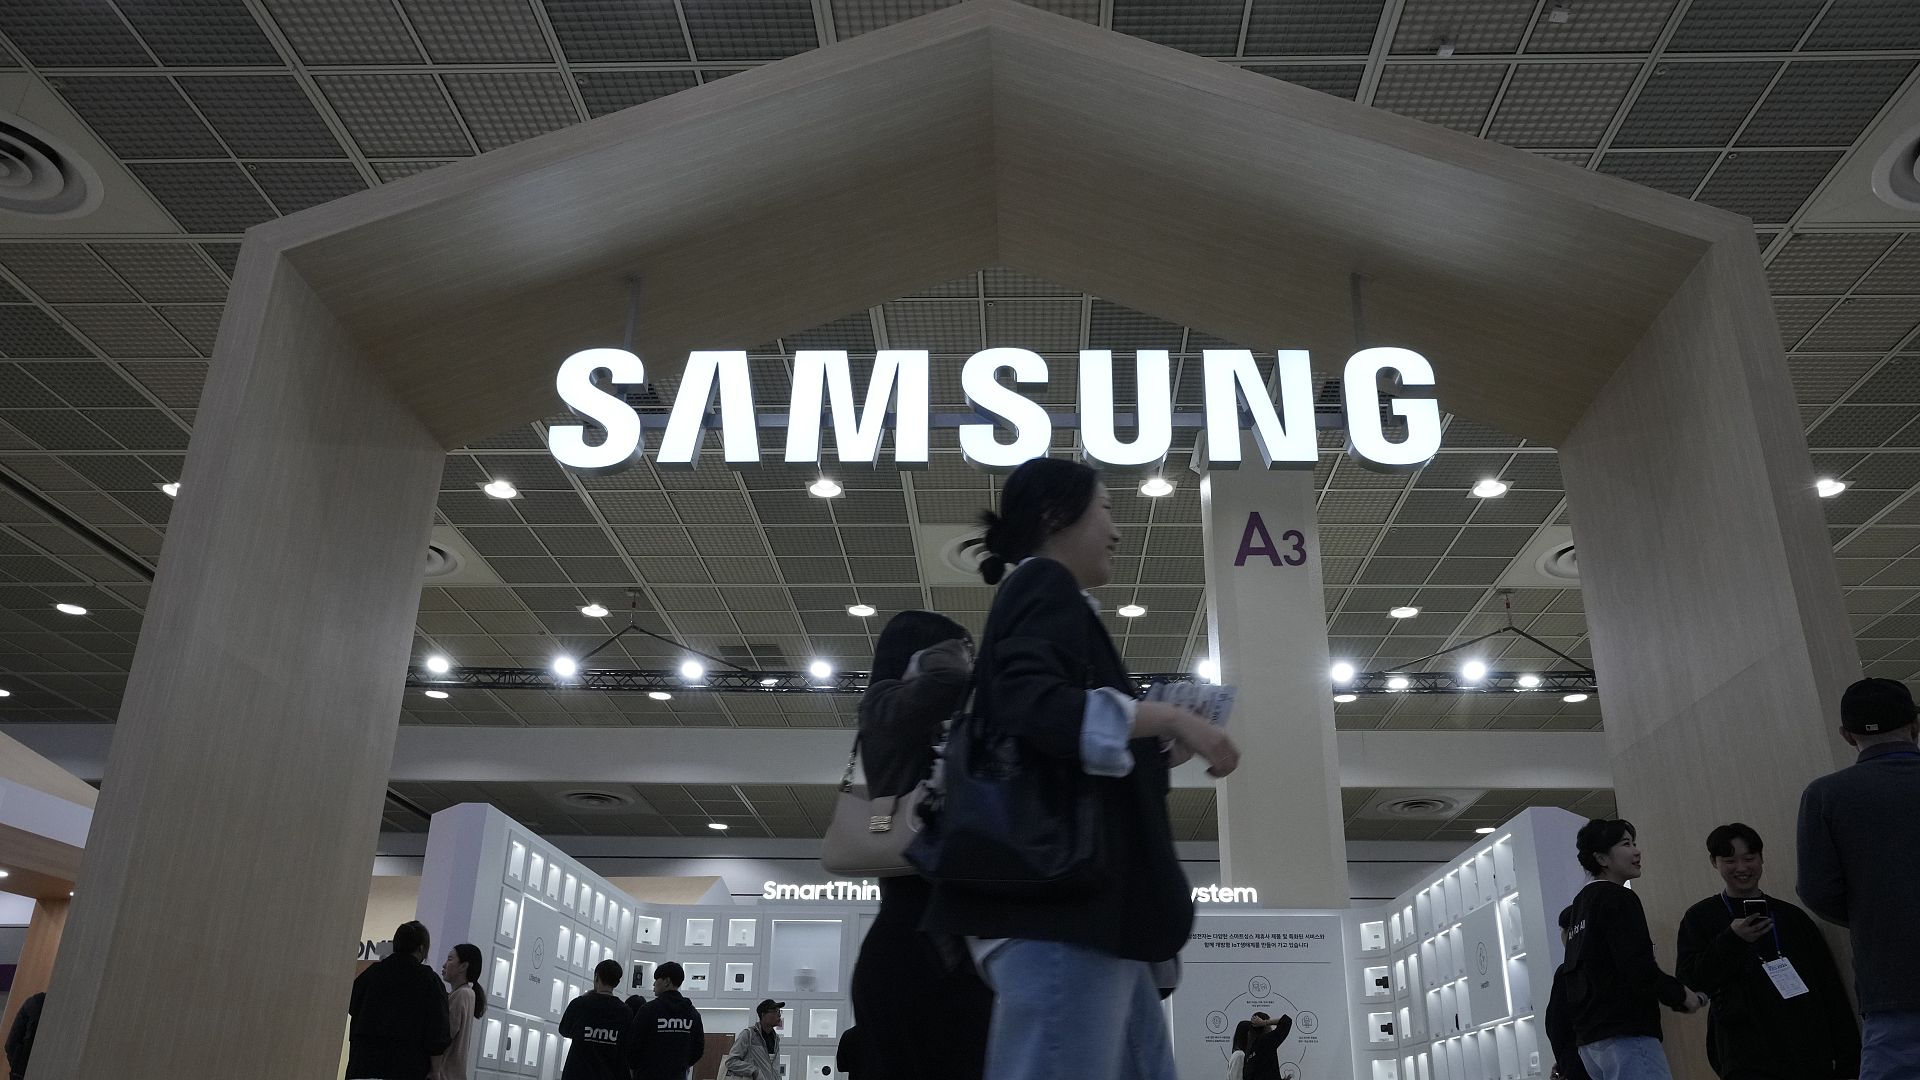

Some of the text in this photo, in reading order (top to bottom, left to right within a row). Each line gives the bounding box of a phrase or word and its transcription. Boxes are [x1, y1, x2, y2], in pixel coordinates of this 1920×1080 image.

[548, 347, 1442, 467] SAMSUNG
[1233, 511, 1307, 567] A3
[762, 879, 1258, 903] SmartThin ystem
